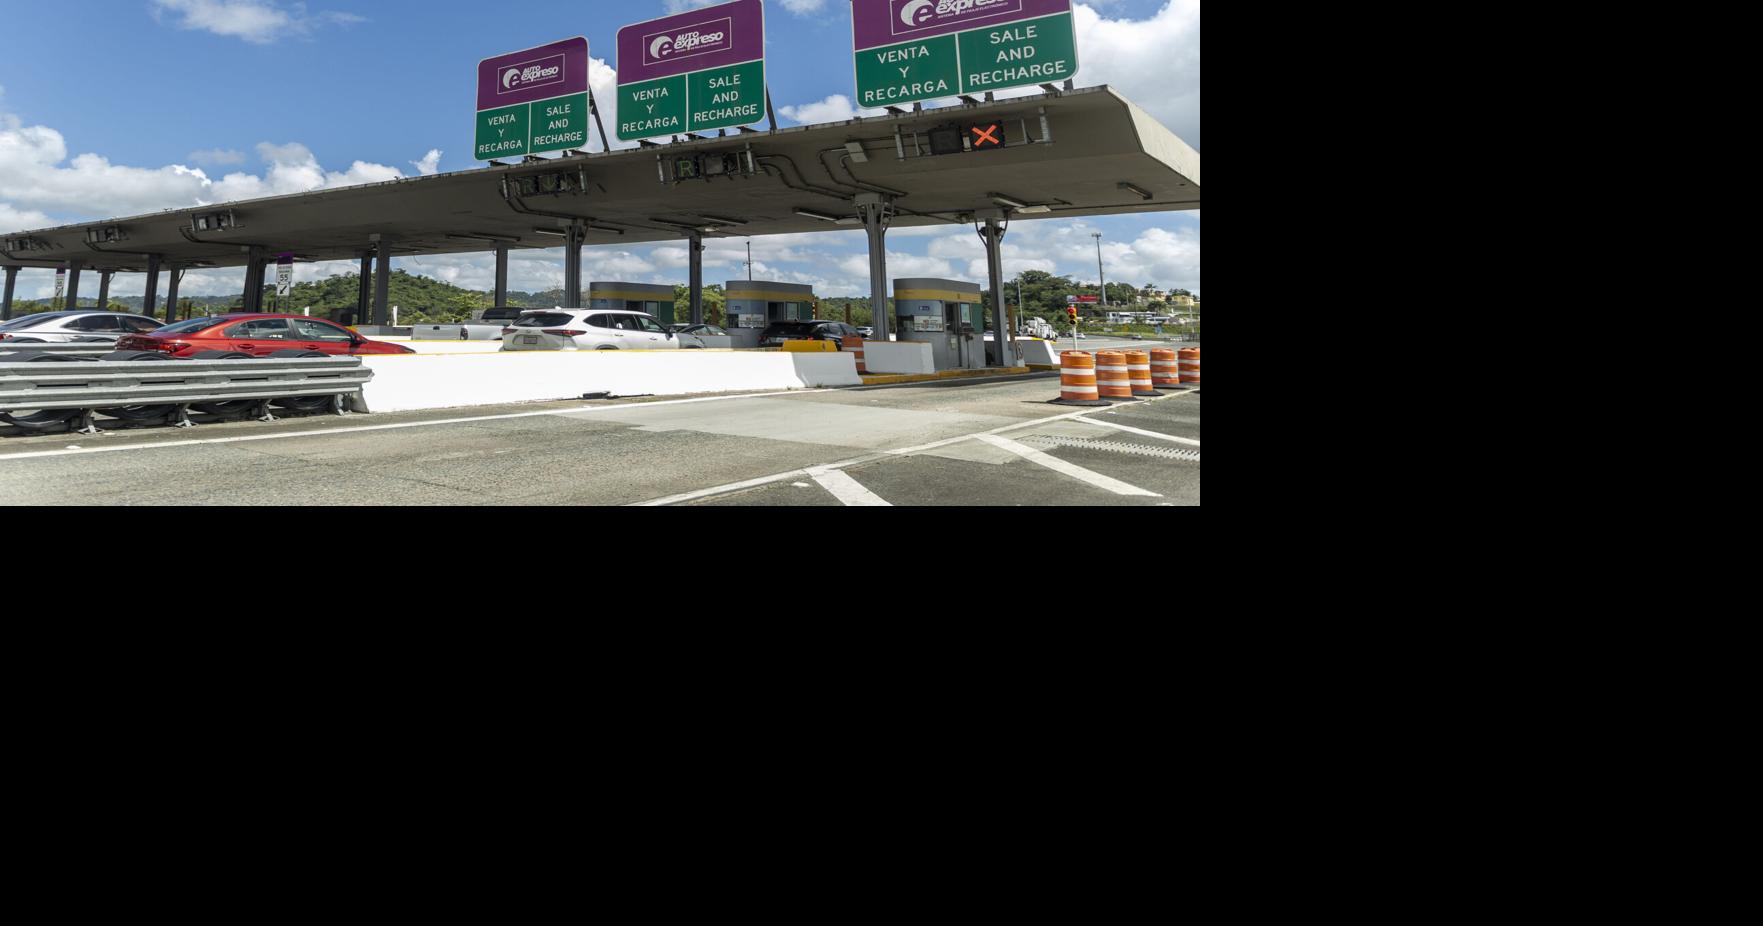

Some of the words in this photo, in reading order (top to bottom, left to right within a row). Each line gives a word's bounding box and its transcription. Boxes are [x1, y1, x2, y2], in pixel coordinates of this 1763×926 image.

[673, 32, 724, 50] expreso
[676, 31, 699, 41] AUTO
[990, 26, 1037, 44] SALE
[877, 45, 930, 64] VENTA
[996, 45, 1035, 63] AND
[521, 66, 559, 82] expreso
[899, 66, 909, 78] Y
[969, 60, 1066, 86] RECHARGE
[709, 74, 741, 88] SALE
[632, 87, 668, 101] VENTA
[712, 91, 738, 104] AND
[865, 79, 948, 102] RECARGA
[546, 104, 570, 116] SALE
[646, 104, 654, 114] Y
[694, 104, 758, 122] RECHARGE
[487, 113, 516, 126] VENTA
[548, 118, 569, 130] AND
[622, 116, 678, 133] RECARGA
[498, 129, 505, 137] Y
[534, 131, 582, 145] RECHARGE
[478, 139, 523, 154] RECARGA
[680, 160, 694, 176] R
